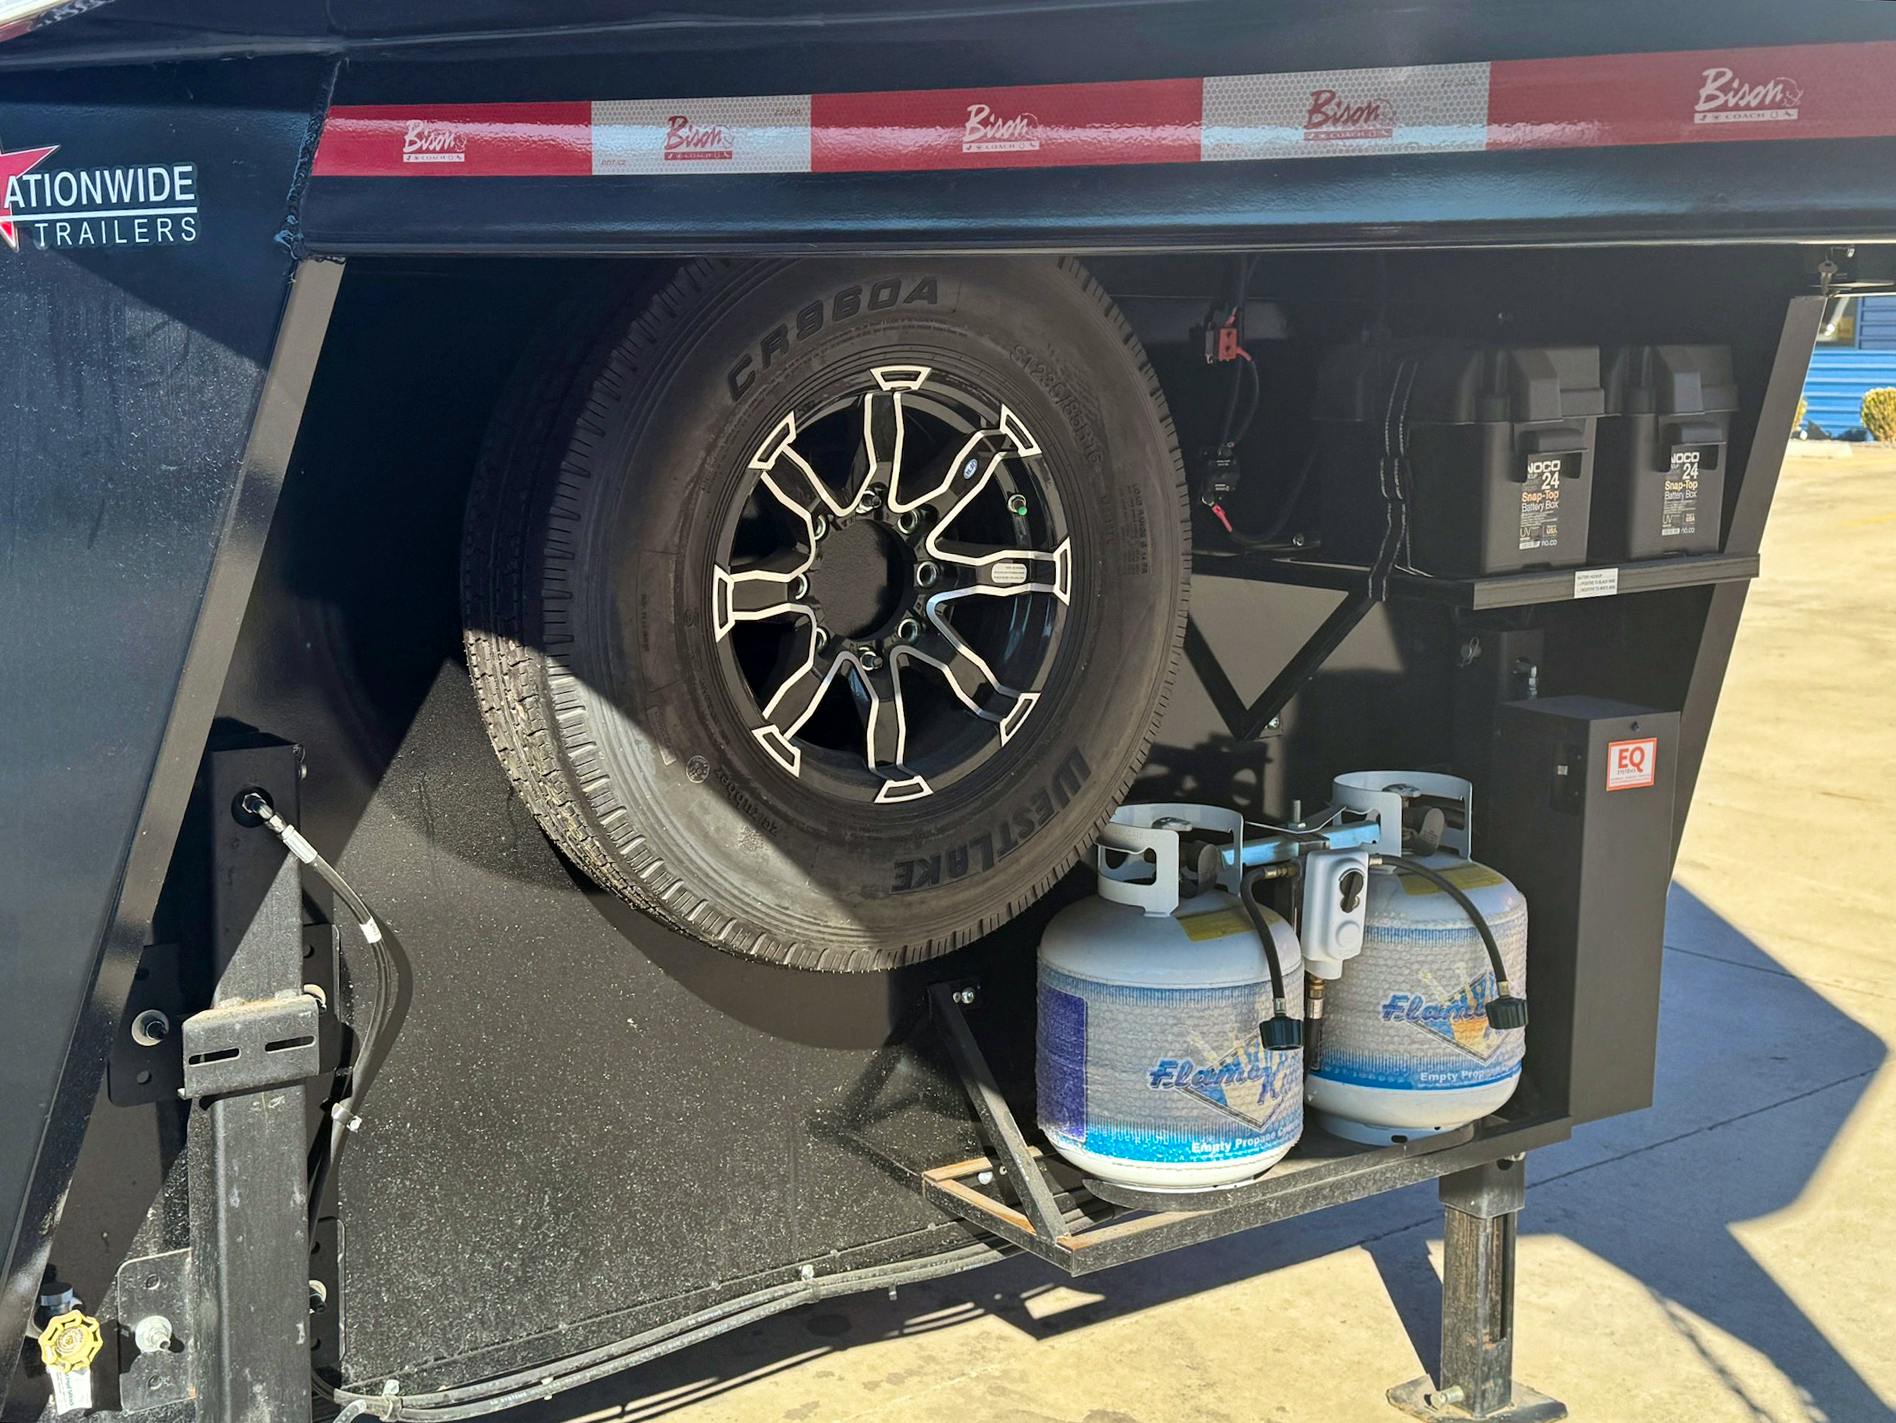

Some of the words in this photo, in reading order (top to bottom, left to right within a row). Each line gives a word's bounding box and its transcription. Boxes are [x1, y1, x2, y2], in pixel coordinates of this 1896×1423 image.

[1694, 67, 1784, 111] Bison
[1304, 89, 1380, 129] Bison
[403, 119, 454, 153] Bison
[664, 115, 722, 150] Bison
[962, 104, 1028, 142] Bison
[4, 165, 195, 208] ATIONWIDE
[34, 216, 197, 247] TRAILERS
[727, 275, 939, 402] CR960A
[1541, 471, 1560, 490] 24
[1682, 463, 1698, 479] 24
[1521, 489, 1559, 503] Snap-Top
[1664, 479, 1698, 491] Snap-Top
[1664, 491, 1685, 502] Battery
[1685, 489, 1697, 499] Box
[1521, 502, 1544, 513] Battery
[1545, 500, 1559, 510] Box
[1618, 746, 1645, 773] EQ
[1420, 1072, 1458, 1084] Empty
[1191, 1139, 1231, 1154] Empty
